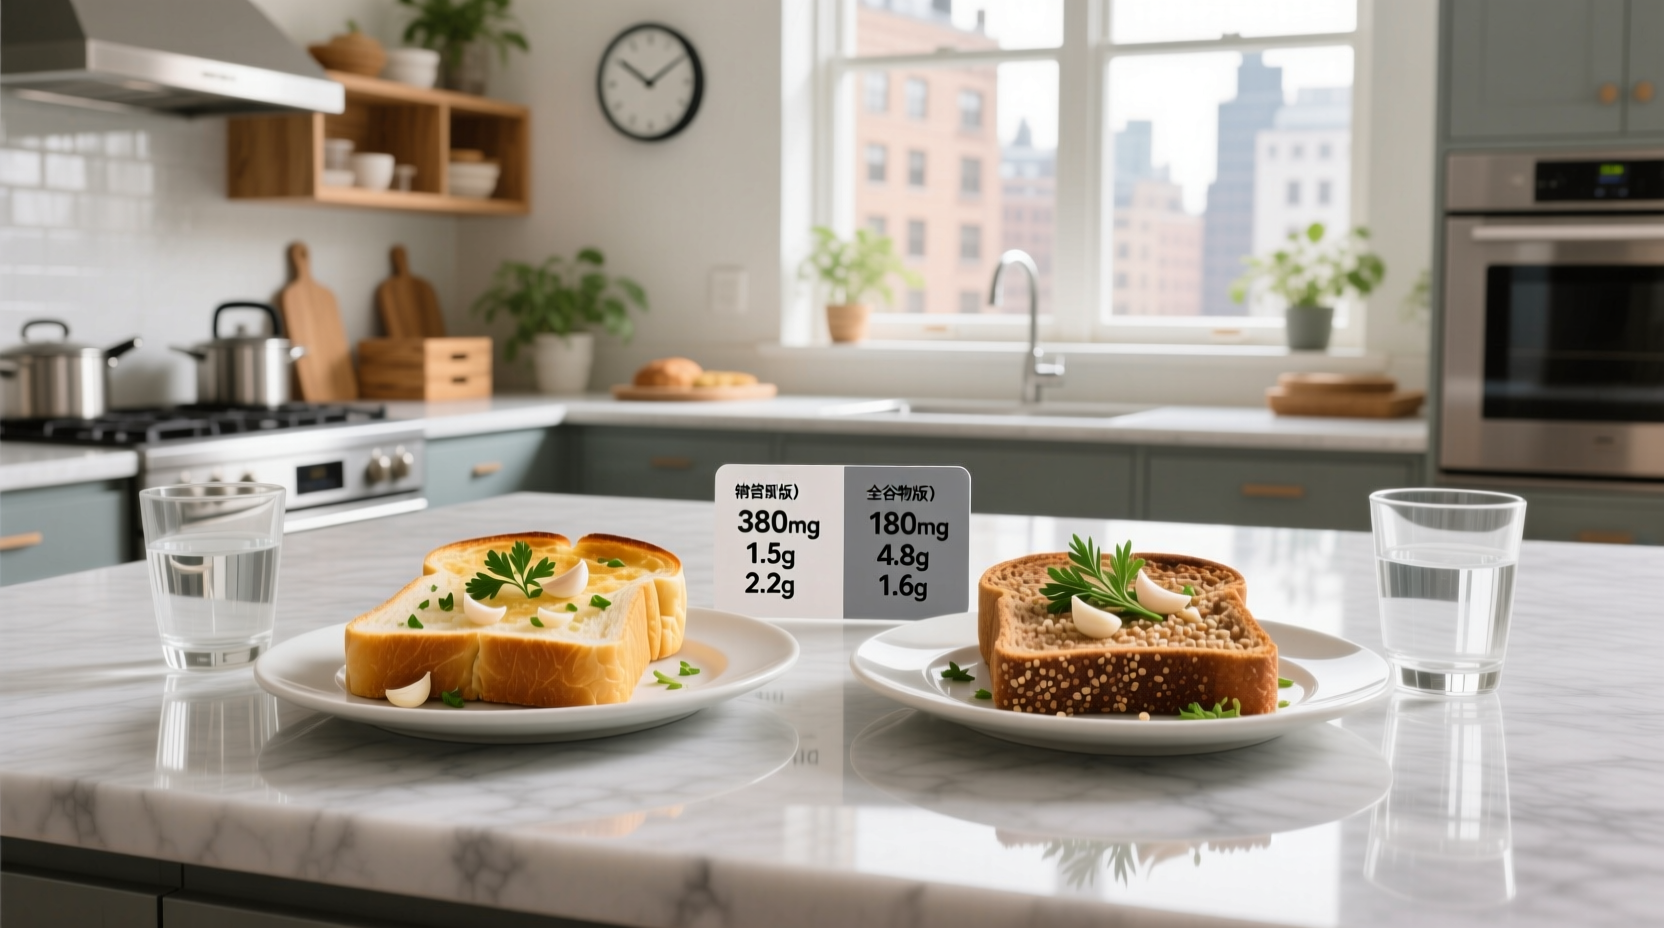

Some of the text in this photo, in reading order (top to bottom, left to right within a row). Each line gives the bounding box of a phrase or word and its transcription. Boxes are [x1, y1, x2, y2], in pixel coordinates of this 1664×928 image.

[737, 509, 820, 540] 380mg
[869, 510, 949, 542] 180mg
[746, 541, 796, 570] 1.5g
[876, 543, 930, 572] 4.8g
[744, 571, 795, 600] 2.2g
[878, 573, 928, 603] 1.6g
